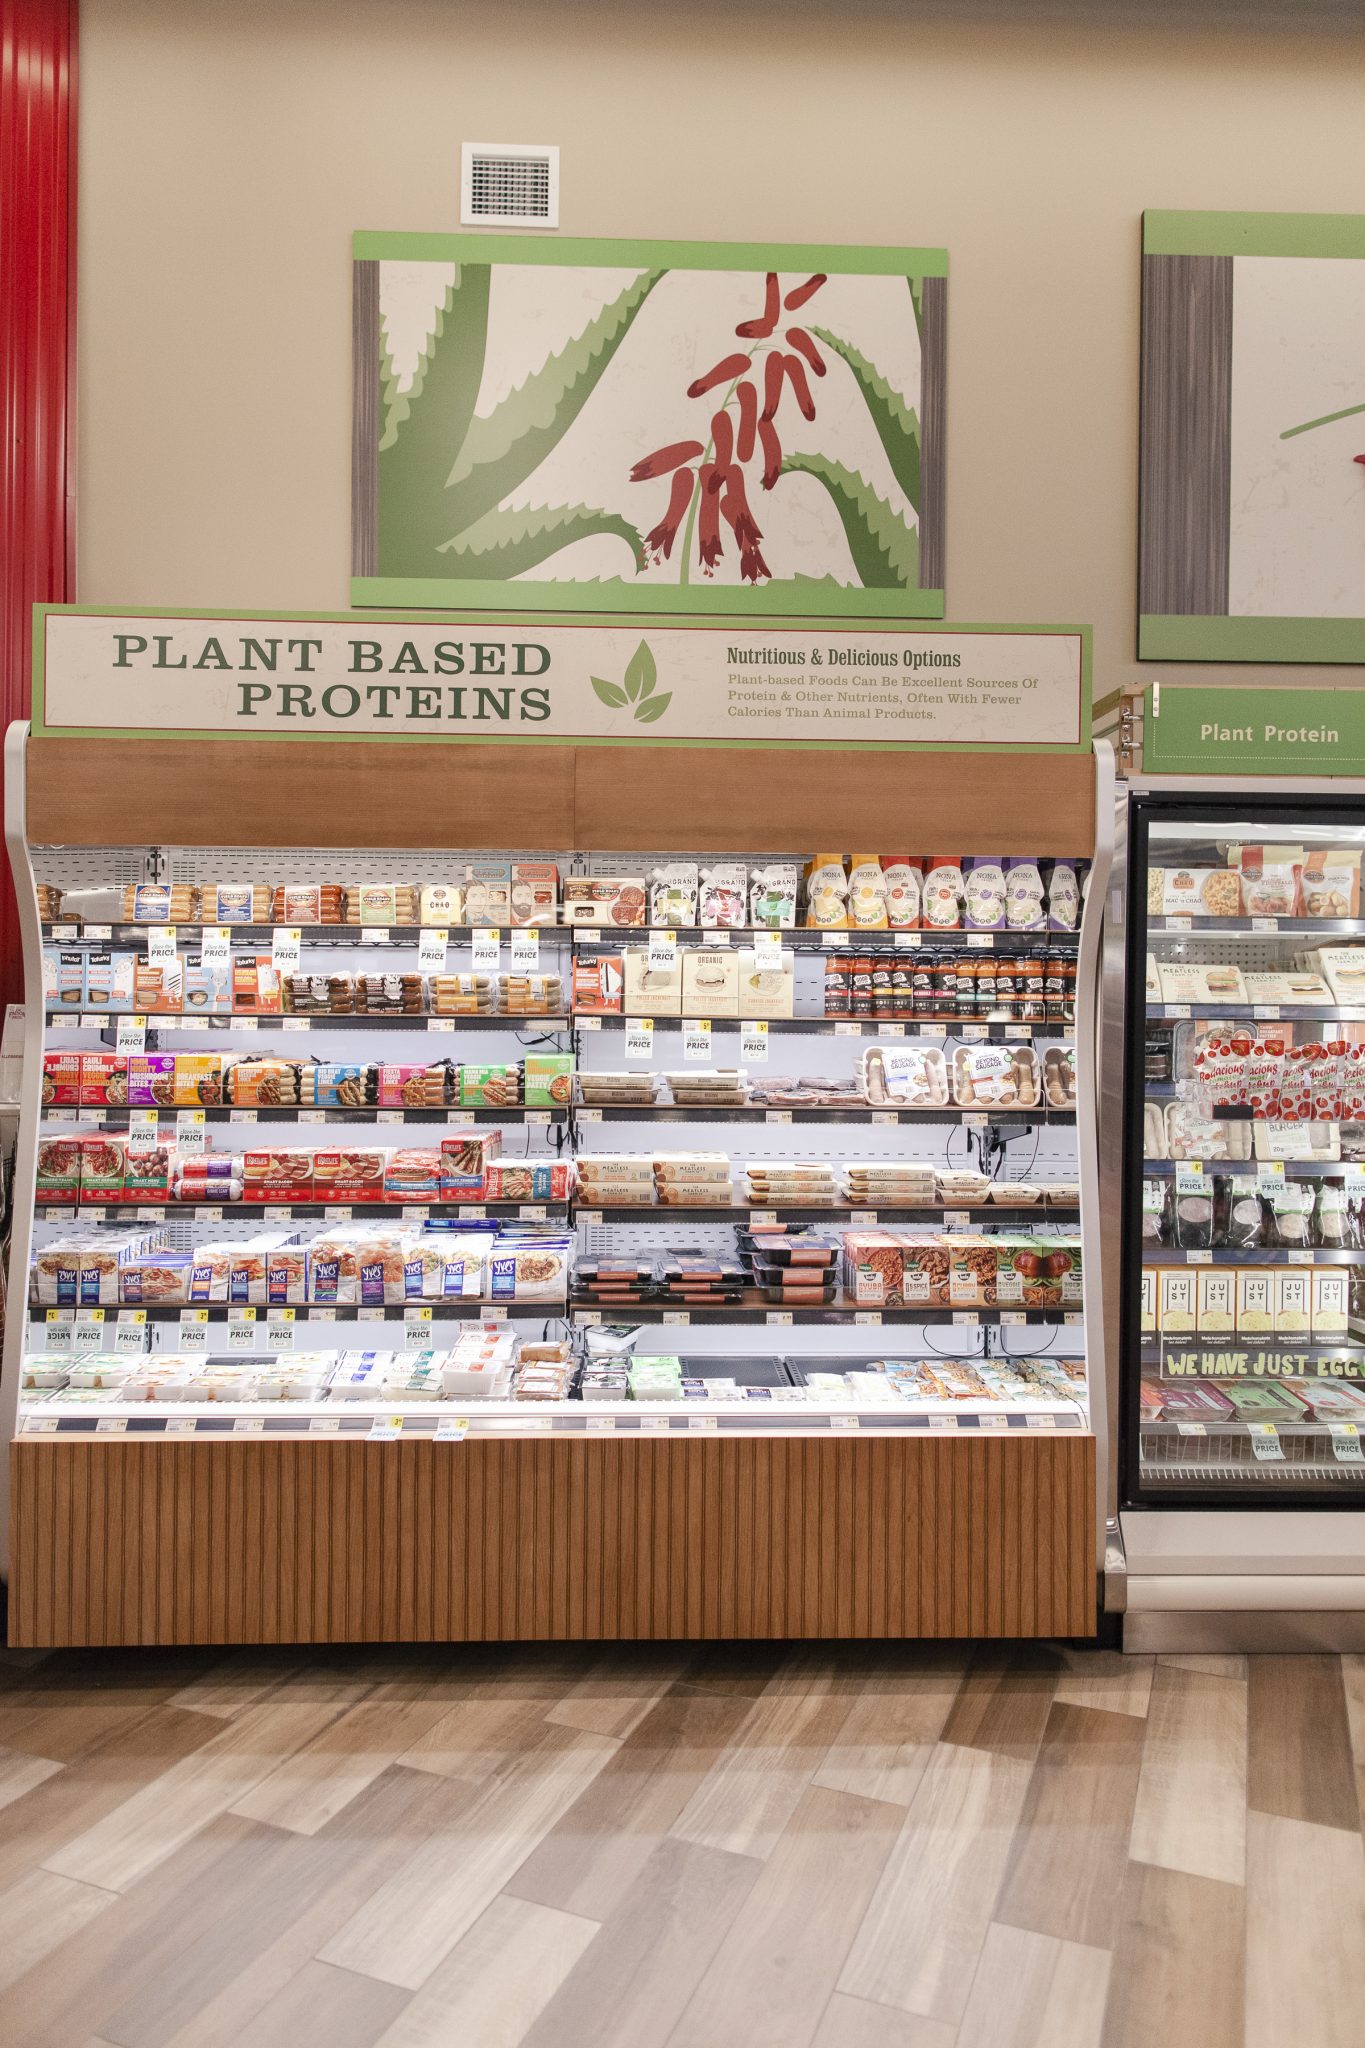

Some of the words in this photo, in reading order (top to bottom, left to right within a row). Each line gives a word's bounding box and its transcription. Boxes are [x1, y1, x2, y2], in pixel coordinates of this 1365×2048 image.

[113, 635, 323, 673] PLANT
[347, 640, 552, 676] BASED
[727, 647, 806, 665] Nutritious
[811, 649, 823, 666] &
[828, 648, 898, 667] Delicious
[903, 650, 961, 670] Options
[728, 674, 804, 686] Plant-based
[809, 675, 848, 687] Foods
[852, 676, 877, 687] Can
[881, 676, 898, 687] Be
[902, 676, 962, 688] Excellent
[967, 677, 1018, 689] Sources
[1022, 678, 1038, 689] Of
[237, 683, 552, 721] PROTEINS
[728, 690, 776, 701] Protein
[780, 691, 791, 702] &
[795, 691, 833, 702] Other
[837, 691, 903, 705] Nutrients,
[907, 693, 943, 703] Often
[948, 693, 977, 704] With
[982, 694, 1022, 705] Fewer
[728, 707, 781, 717] Calories
[786, 707, 819, 718] Than
[823, 708, 870, 719] Animal
[875, 709, 936, 720] Products.
[1201, 724, 1253, 741] Plant
[1264, 725, 1339, 742] Protein
[976, 1057, 999, 1065] BEYOND
[1167, 1353, 1198, 1376] WE
[1202, 1353, 1248, 1375] HAVE
[1253, 1352, 1310, 1375] JUST
[1317, 1357, 1358, 1376] EGG
